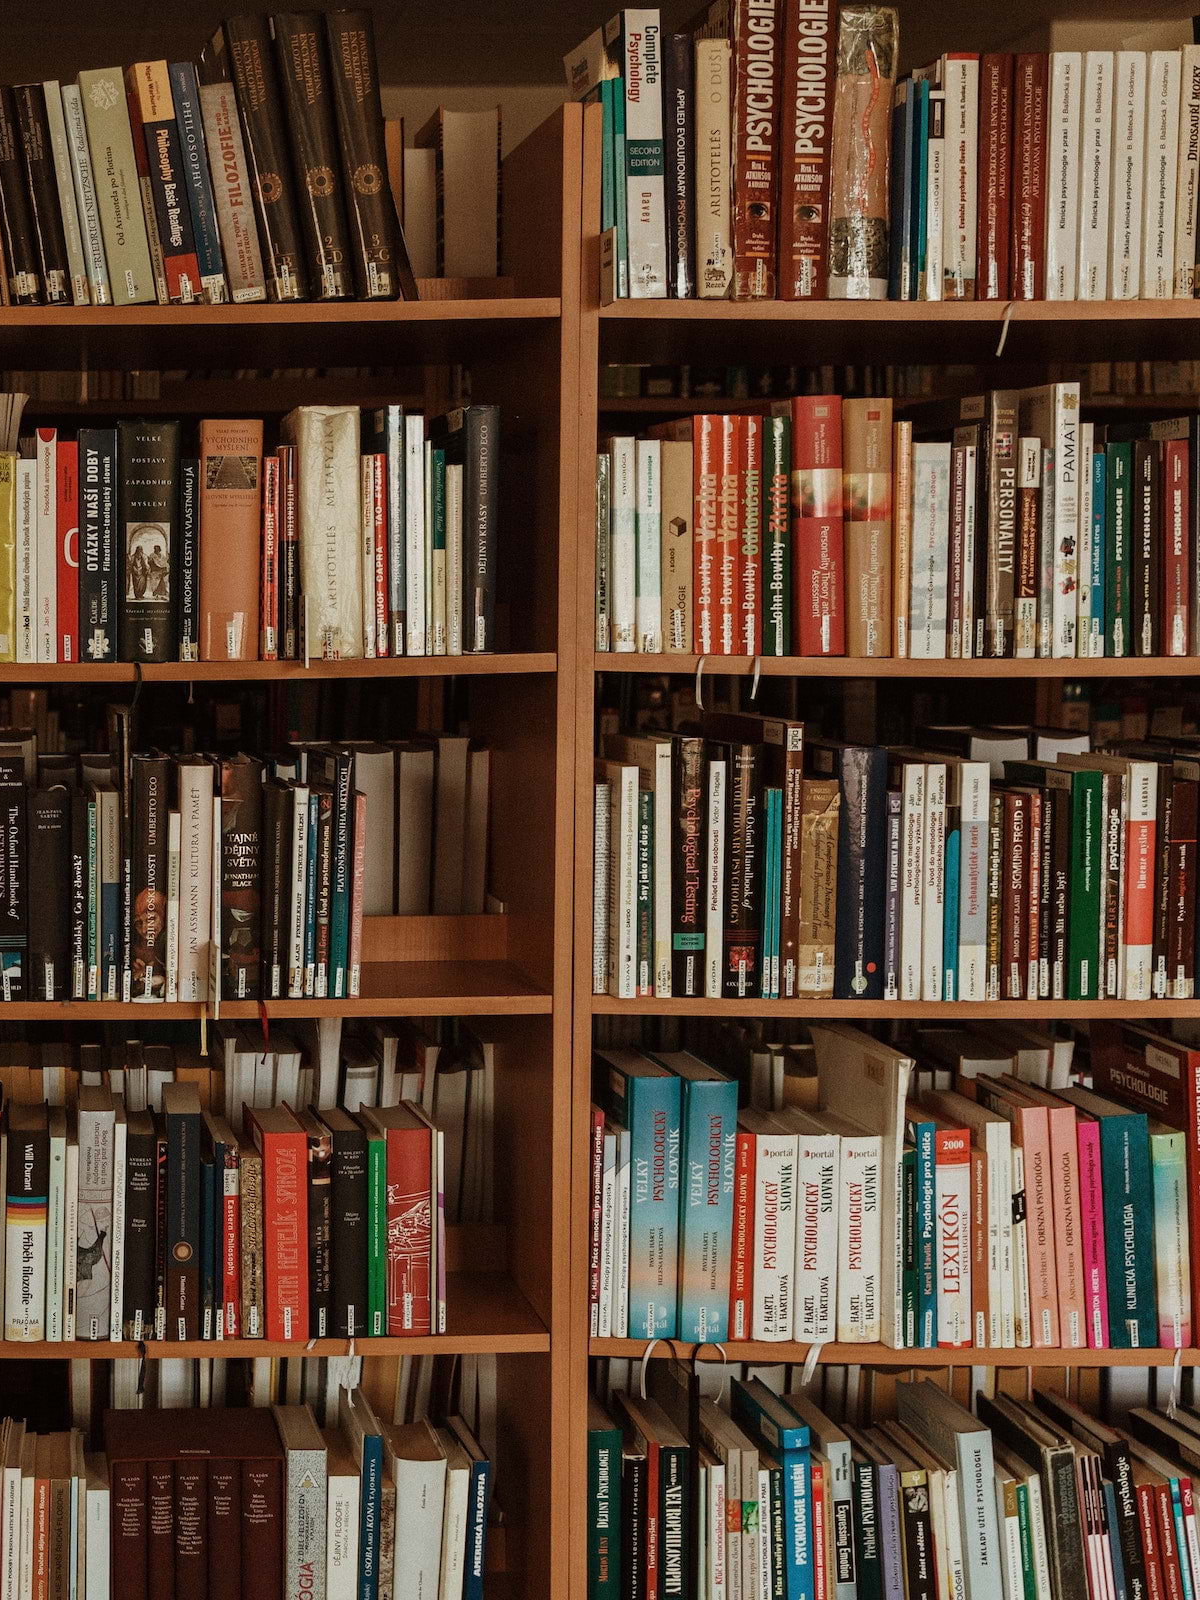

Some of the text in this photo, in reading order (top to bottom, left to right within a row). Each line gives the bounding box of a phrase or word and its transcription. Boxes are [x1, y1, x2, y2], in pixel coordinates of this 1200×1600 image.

[628, 24, 659, 104] Complete Psychology
[182, 101, 203, 189] PHILOSOPHY
[217, 127, 244, 207] FILOZOFIE
[163, 182, 183, 247] Basic Readings
[639, 190, 652, 226] Davey
[86, 448, 99, 572] OTÁZKY NAŠÍ DOBY
[477, 425, 488, 535] KRÁSY UMBERTO ECO
[695, 474, 717, 543] Vazba
[717, 474, 737, 543] Vazba
[769, 473, 788, 534] Ztráta
[997, 468, 1014, 574] PERSONALITY
[148, 797, 157, 845] UMBERTO
[224, 844, 260, 856] DĚJINY
[227, 833, 258, 843] TAJNÉ
[681, 786, 701, 925] Psychological Testing
[1012, 810, 1024, 889] SIGMUND FREUD
[1108, 808, 1121, 871] psychologie
[8, 825, 19, 904] Oxford Handbook
[190, 839, 199, 878] KULTURA
[226, 856, 257, 868] SVĚTA
[190, 885, 199, 934] ASSMANN
[24, 1164, 32, 1191] Durant
[652, 1108, 668, 1202] PSYCHOLOGICKÝ
[667, 1127, 680, 1191] SLOVNÍK
[942, 1140, 964, 1150] 2000
[635, 1159, 649, 1204] VELKÝ
[780, 1164, 793, 1213] SLOVNÍK
[821, 1165, 834, 1213] SLOVNÍK
[923, 1181, 934, 1238] Psychologie
[226, 1200, 235, 1277] Eastern Philosophy
[762, 1179, 779, 1272] PSYCHOLOGICKÝ
[803, 1181, 819, 1272] PSYCHOLOGICKÝ
[942, 1193, 961, 1296] LEXIKÓN
[859, 1465, 875, 1524] PSYCHOLOGIE
[973, 1449, 985, 1503] PSYCHOLOGIE
[364, 1502, 375, 1577] OSOBA IKONA
[473, 1472, 487, 1577] AMERICKÁ FILOZOFIA
[794, 1492, 809, 1566] PSYCHOLOGIE
[837, 1504, 853, 1579] Expressing Emotion
